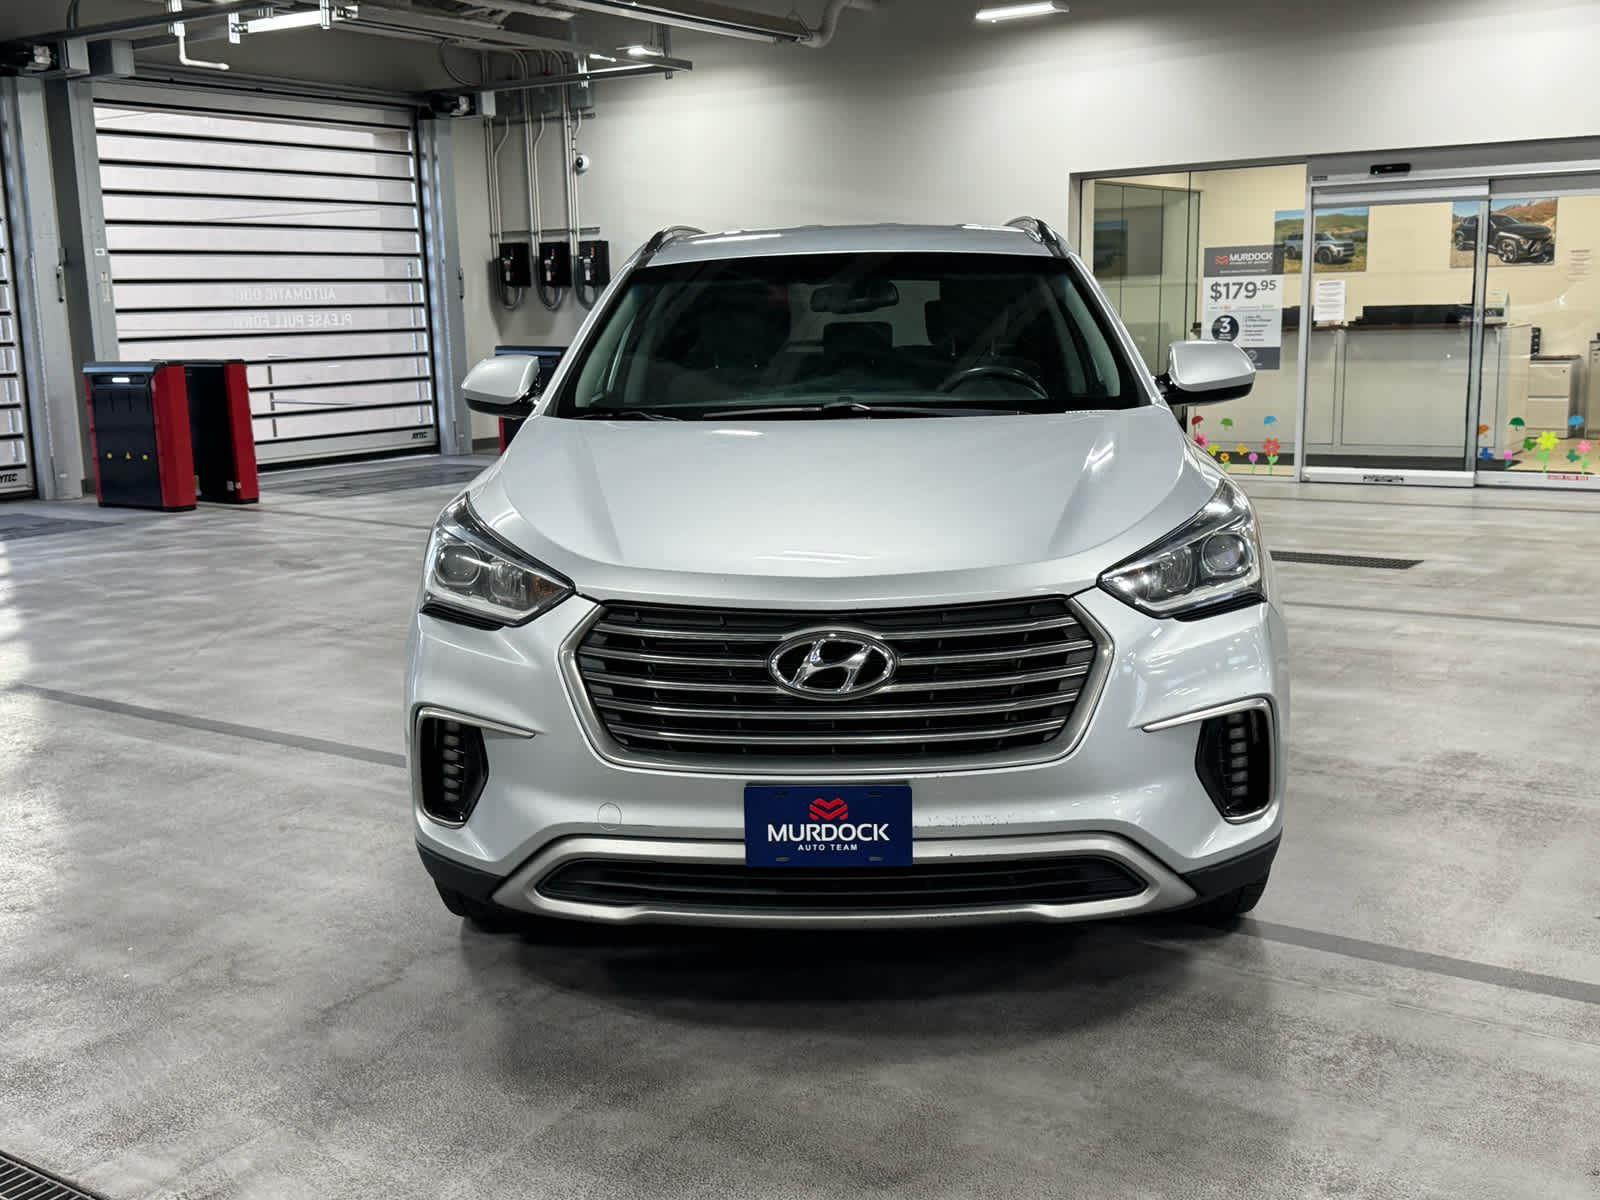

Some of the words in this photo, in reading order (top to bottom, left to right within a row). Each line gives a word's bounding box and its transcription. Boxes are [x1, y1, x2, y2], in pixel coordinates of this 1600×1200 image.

[1229, 252, 1272, 261] MURDOCK
[1210, 280, 1276, 301] $179.95
[1220, 317, 1231, 333] 3
[767, 823, 890, 842] MURDOCK
